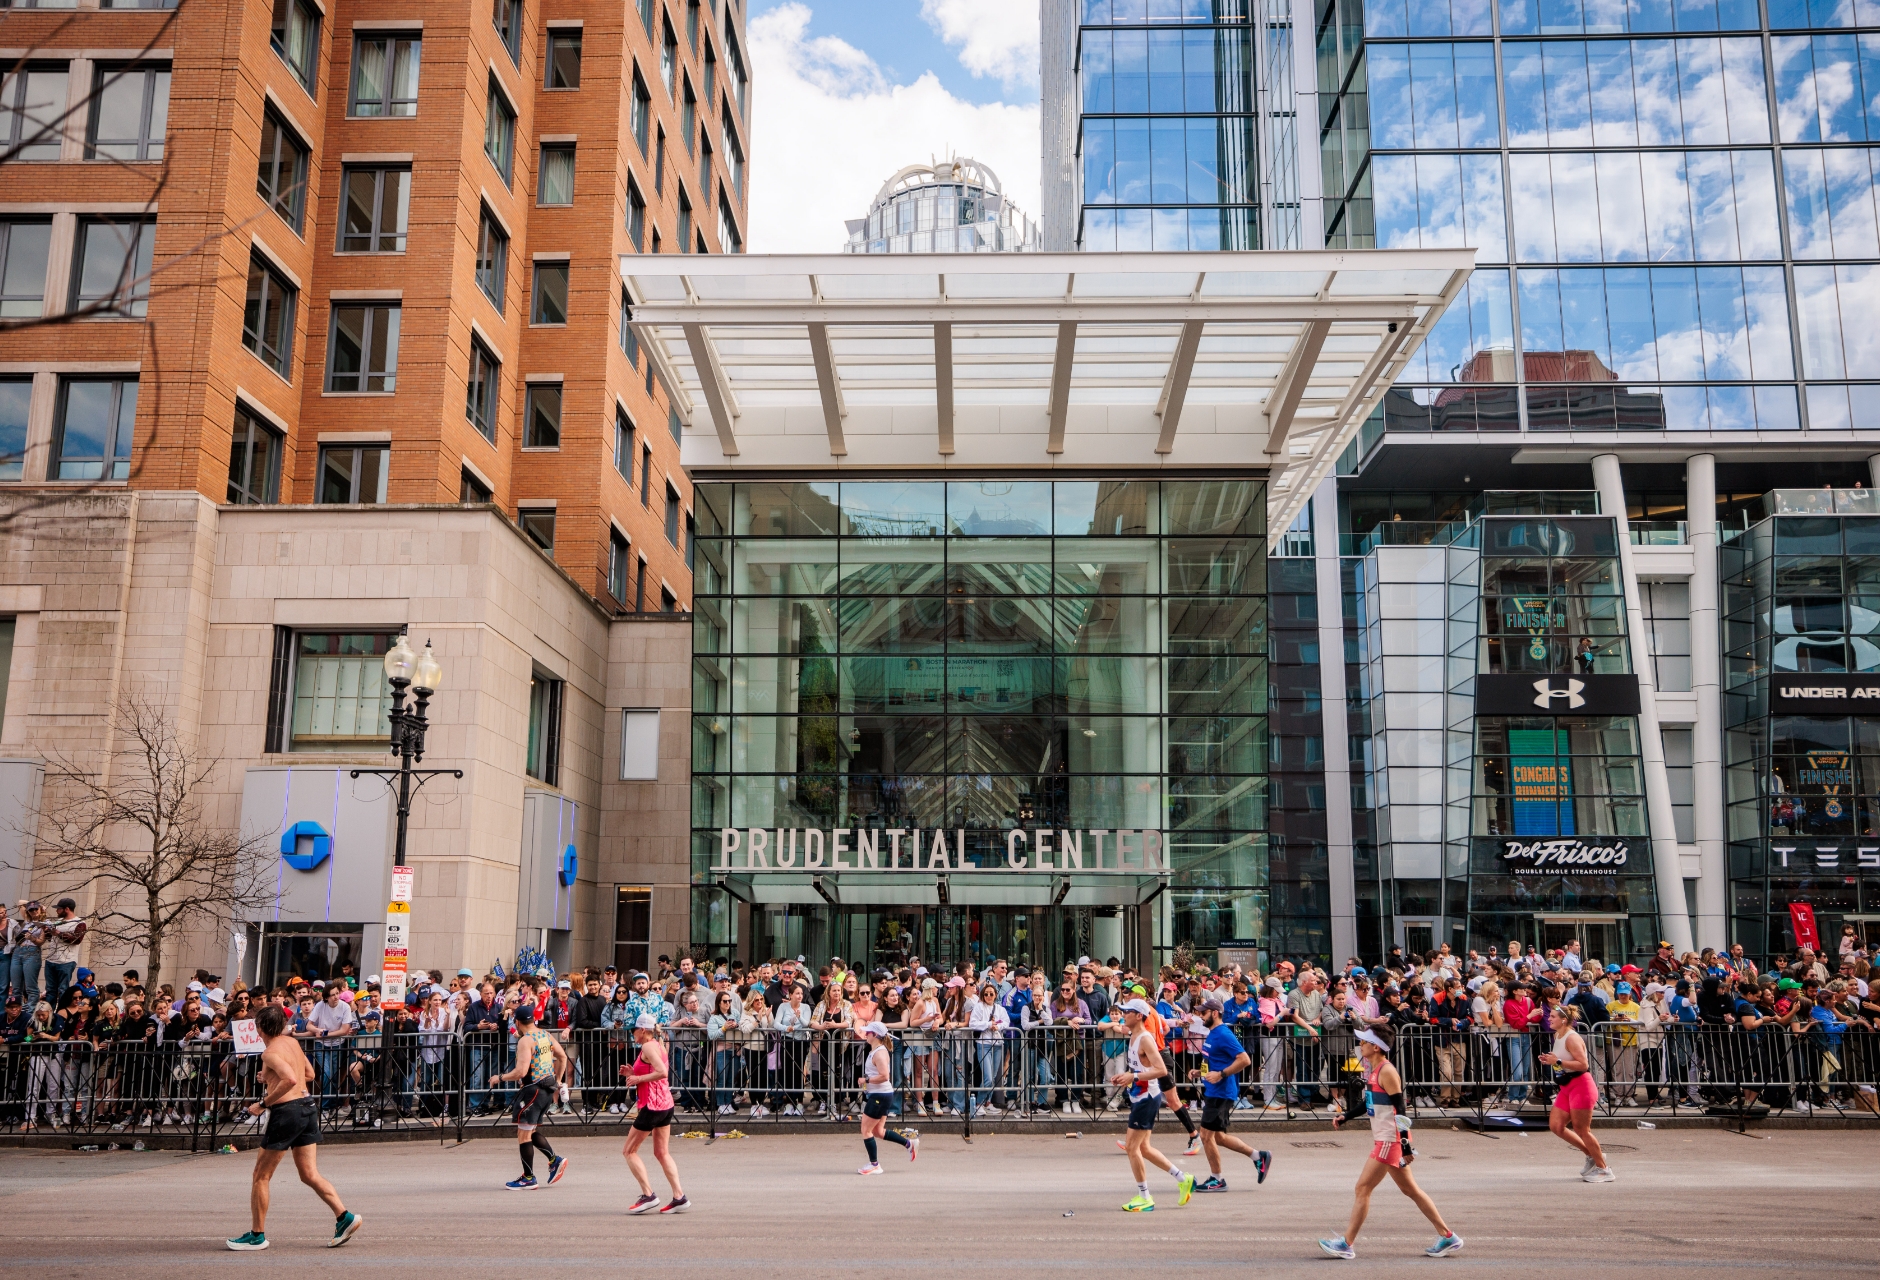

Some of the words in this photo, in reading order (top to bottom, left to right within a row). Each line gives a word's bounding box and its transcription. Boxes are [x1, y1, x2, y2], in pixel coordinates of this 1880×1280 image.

[1506, 613, 1565, 628] FINISHR
[1780, 687, 1847, 698] UNDER
[1514, 766, 1568, 782] CONGRAS
[721, 827, 976, 869] PRUDENTIAL
[1007, 828, 1164, 870] CENTER
[1504, 841, 1541, 858] Del
[1534, 840, 1628, 866] Frisco's
[238, 1022, 254, 1032] GO
